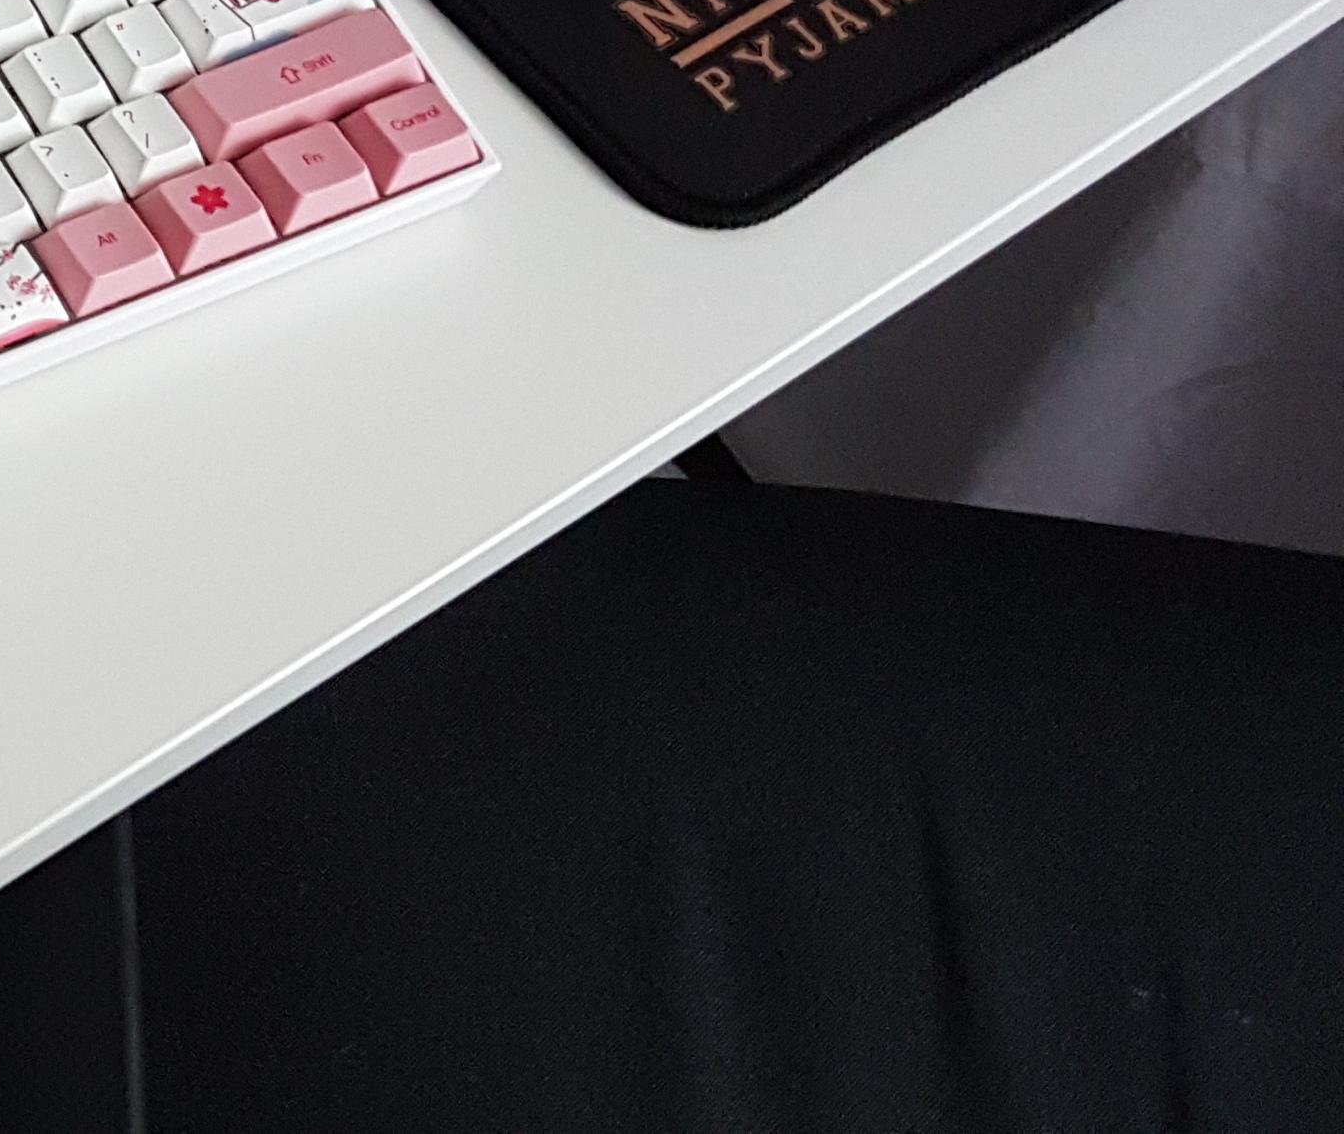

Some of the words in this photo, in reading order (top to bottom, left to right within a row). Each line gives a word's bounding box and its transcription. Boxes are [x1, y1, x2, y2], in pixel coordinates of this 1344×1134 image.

[302, 54, 335, 75] Shift
[390, 105, 440, 132] Control
[302, 152, 323, 166] Fn
[97, 232, 119, 247] Alt
